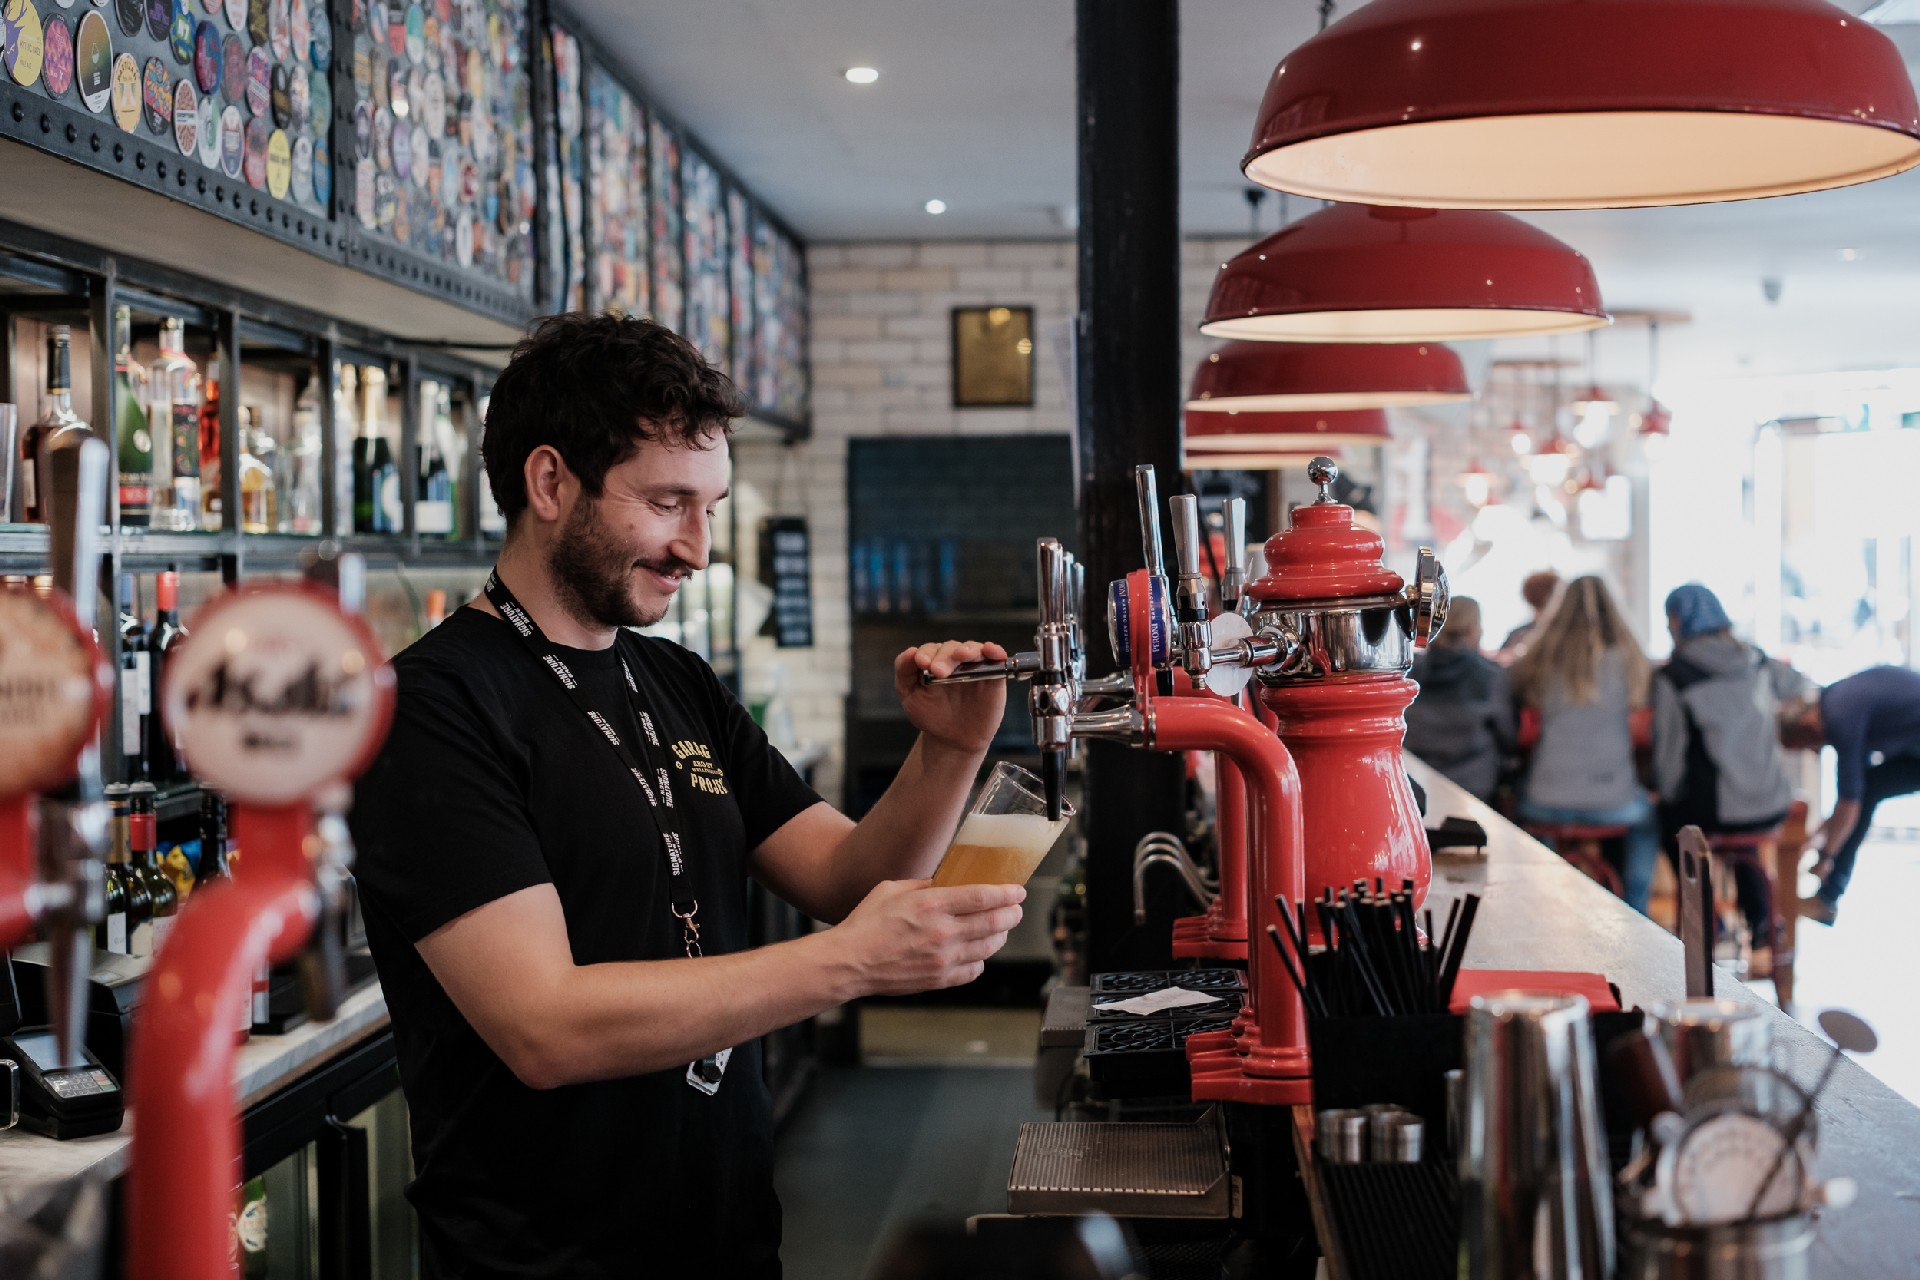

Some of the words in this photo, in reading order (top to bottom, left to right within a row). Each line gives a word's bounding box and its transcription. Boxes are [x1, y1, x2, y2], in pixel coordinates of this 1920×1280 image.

[500, 602, 532, 637] SIGNATURE
[1152, 622, 1160, 653] PERONI
[543, 654, 576, 689] SIGNATURE
[587, 710, 620, 746] SIGNATURE
[672, 740, 711, 759] GARAG
[660, 767, 674, 808] SIGNATURE
[691, 772, 728, 795] PROJEC
[662, 832, 681, 876] SIGNATURE
